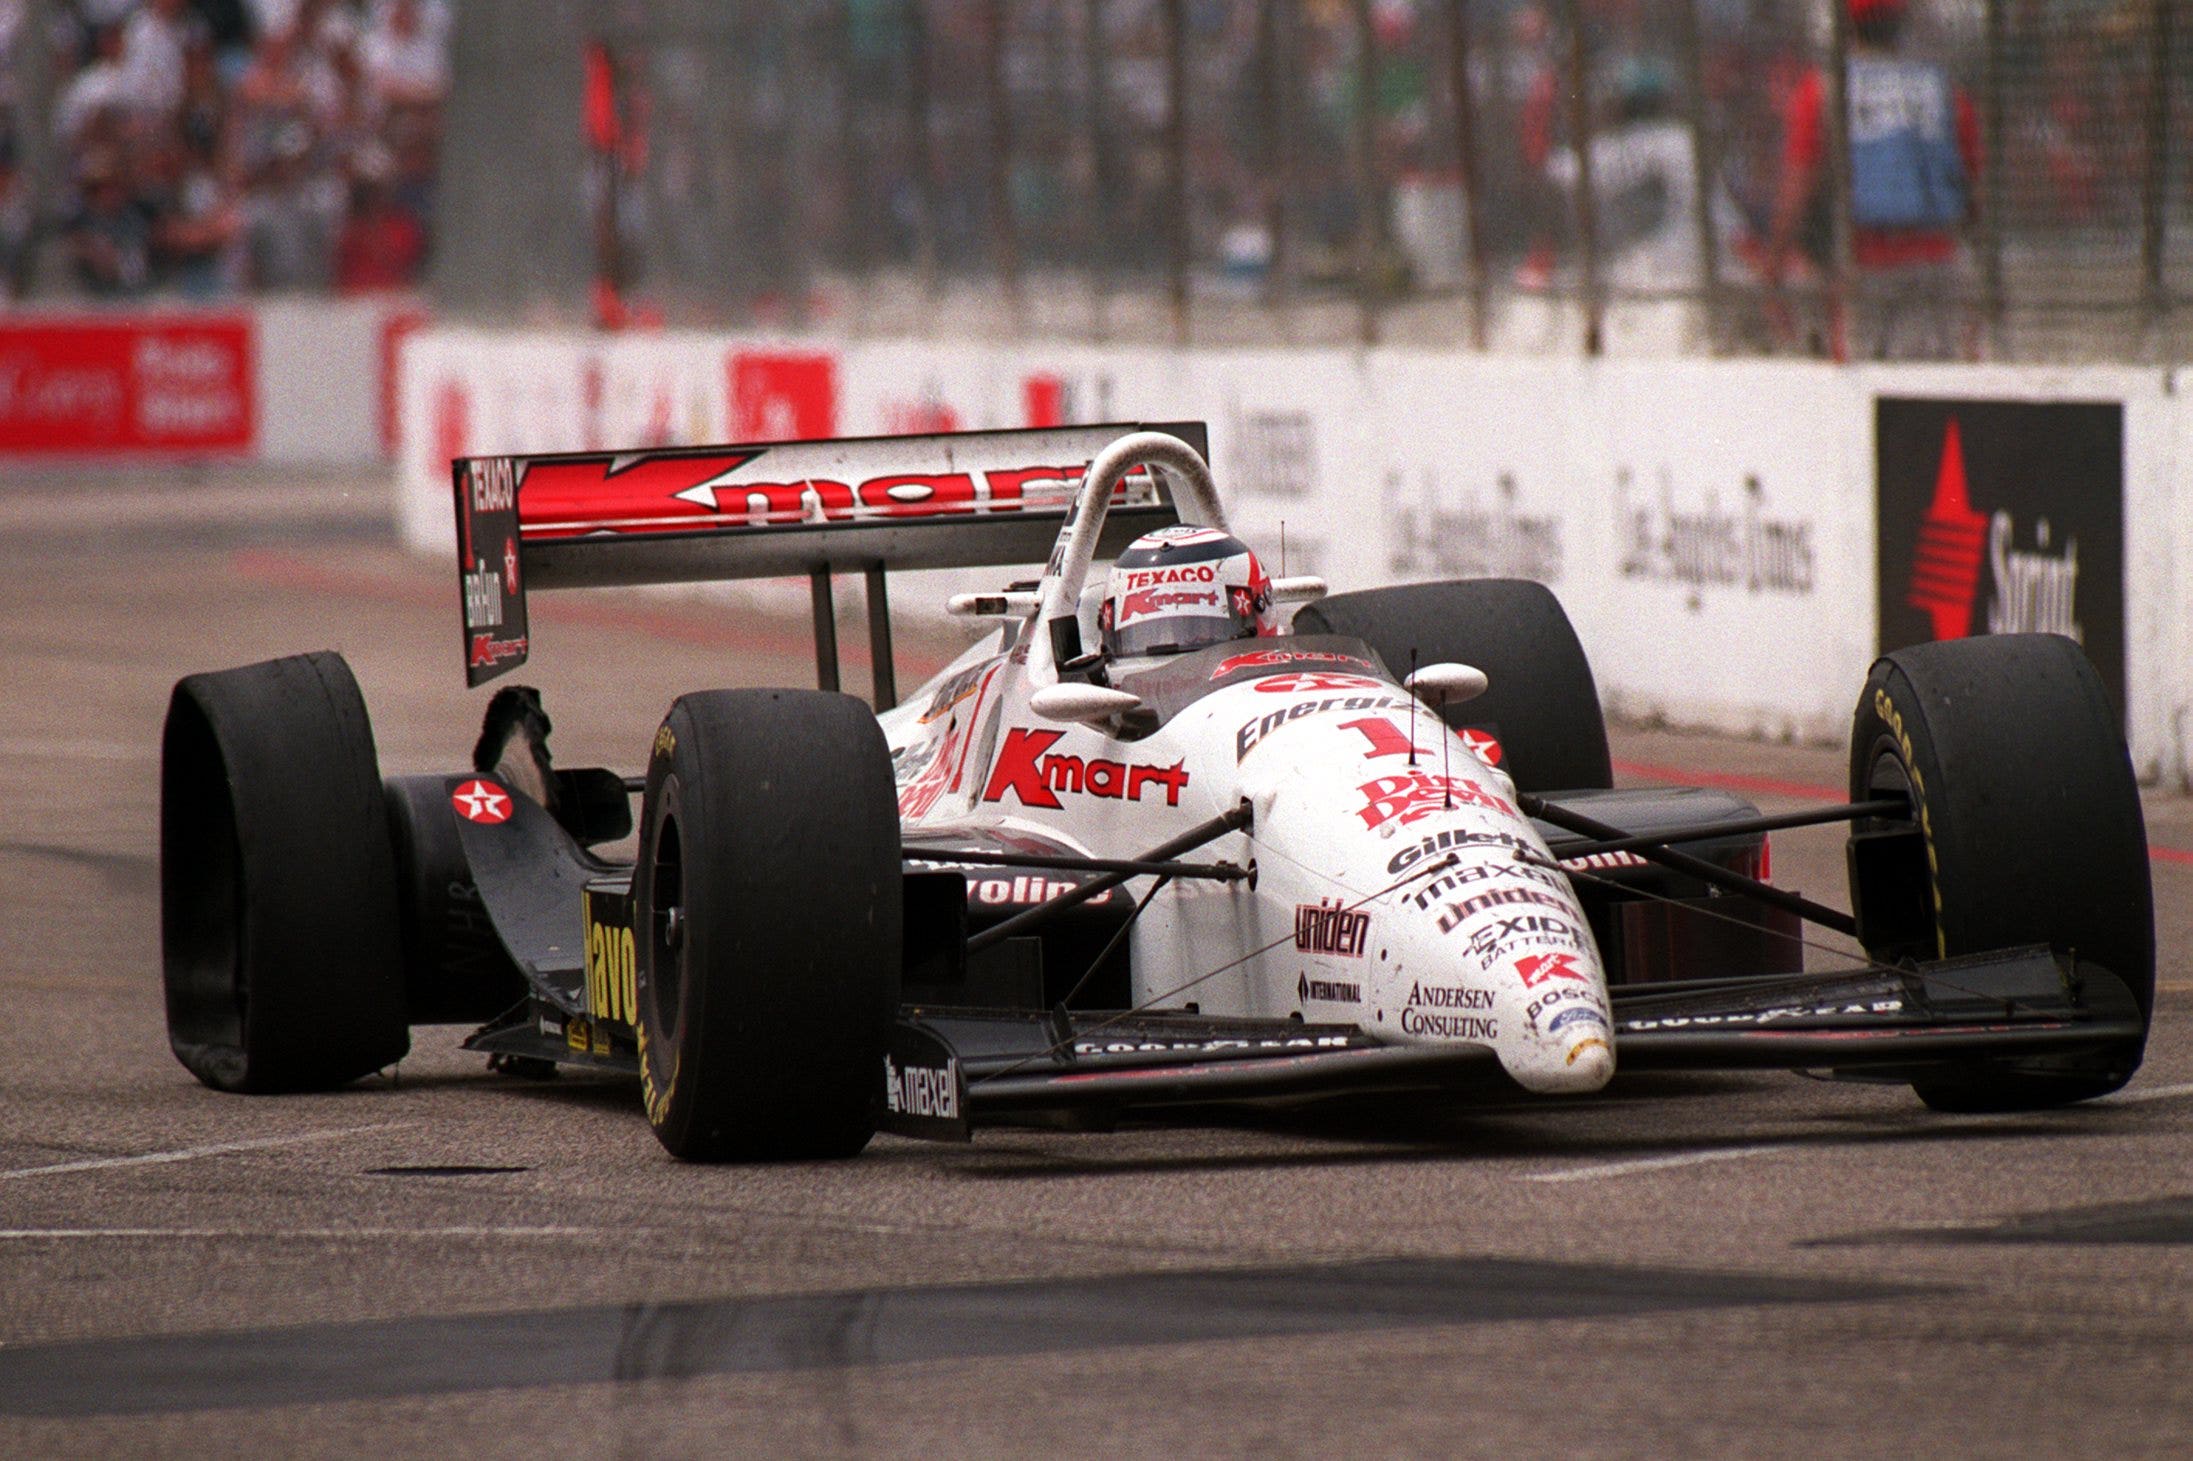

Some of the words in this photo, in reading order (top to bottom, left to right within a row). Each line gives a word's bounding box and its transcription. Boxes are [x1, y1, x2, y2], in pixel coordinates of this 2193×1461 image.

[470, 458, 513, 511] TEXACO
[1126, 566, 1215, 591] TEXACO
[1120, 586, 1219, 622] Kmart
[470, 632, 528, 667] Kmart
[1337, 717, 1436, 760] 1
[982, 727, 1190, 811] Kmart
[1355, 770, 1482, 806] Dirt
[1355, 788, 1521, 831] Devil
[1295, 897, 1371, 959] uniden
[1308, 980, 1362, 1004] INTERNATIONAL
[1408, 981, 1496, 1011] ANDERSEN
[1401, 1008, 1499, 1040] CONSULTING
[904, 1057, 959, 1120] maxell
